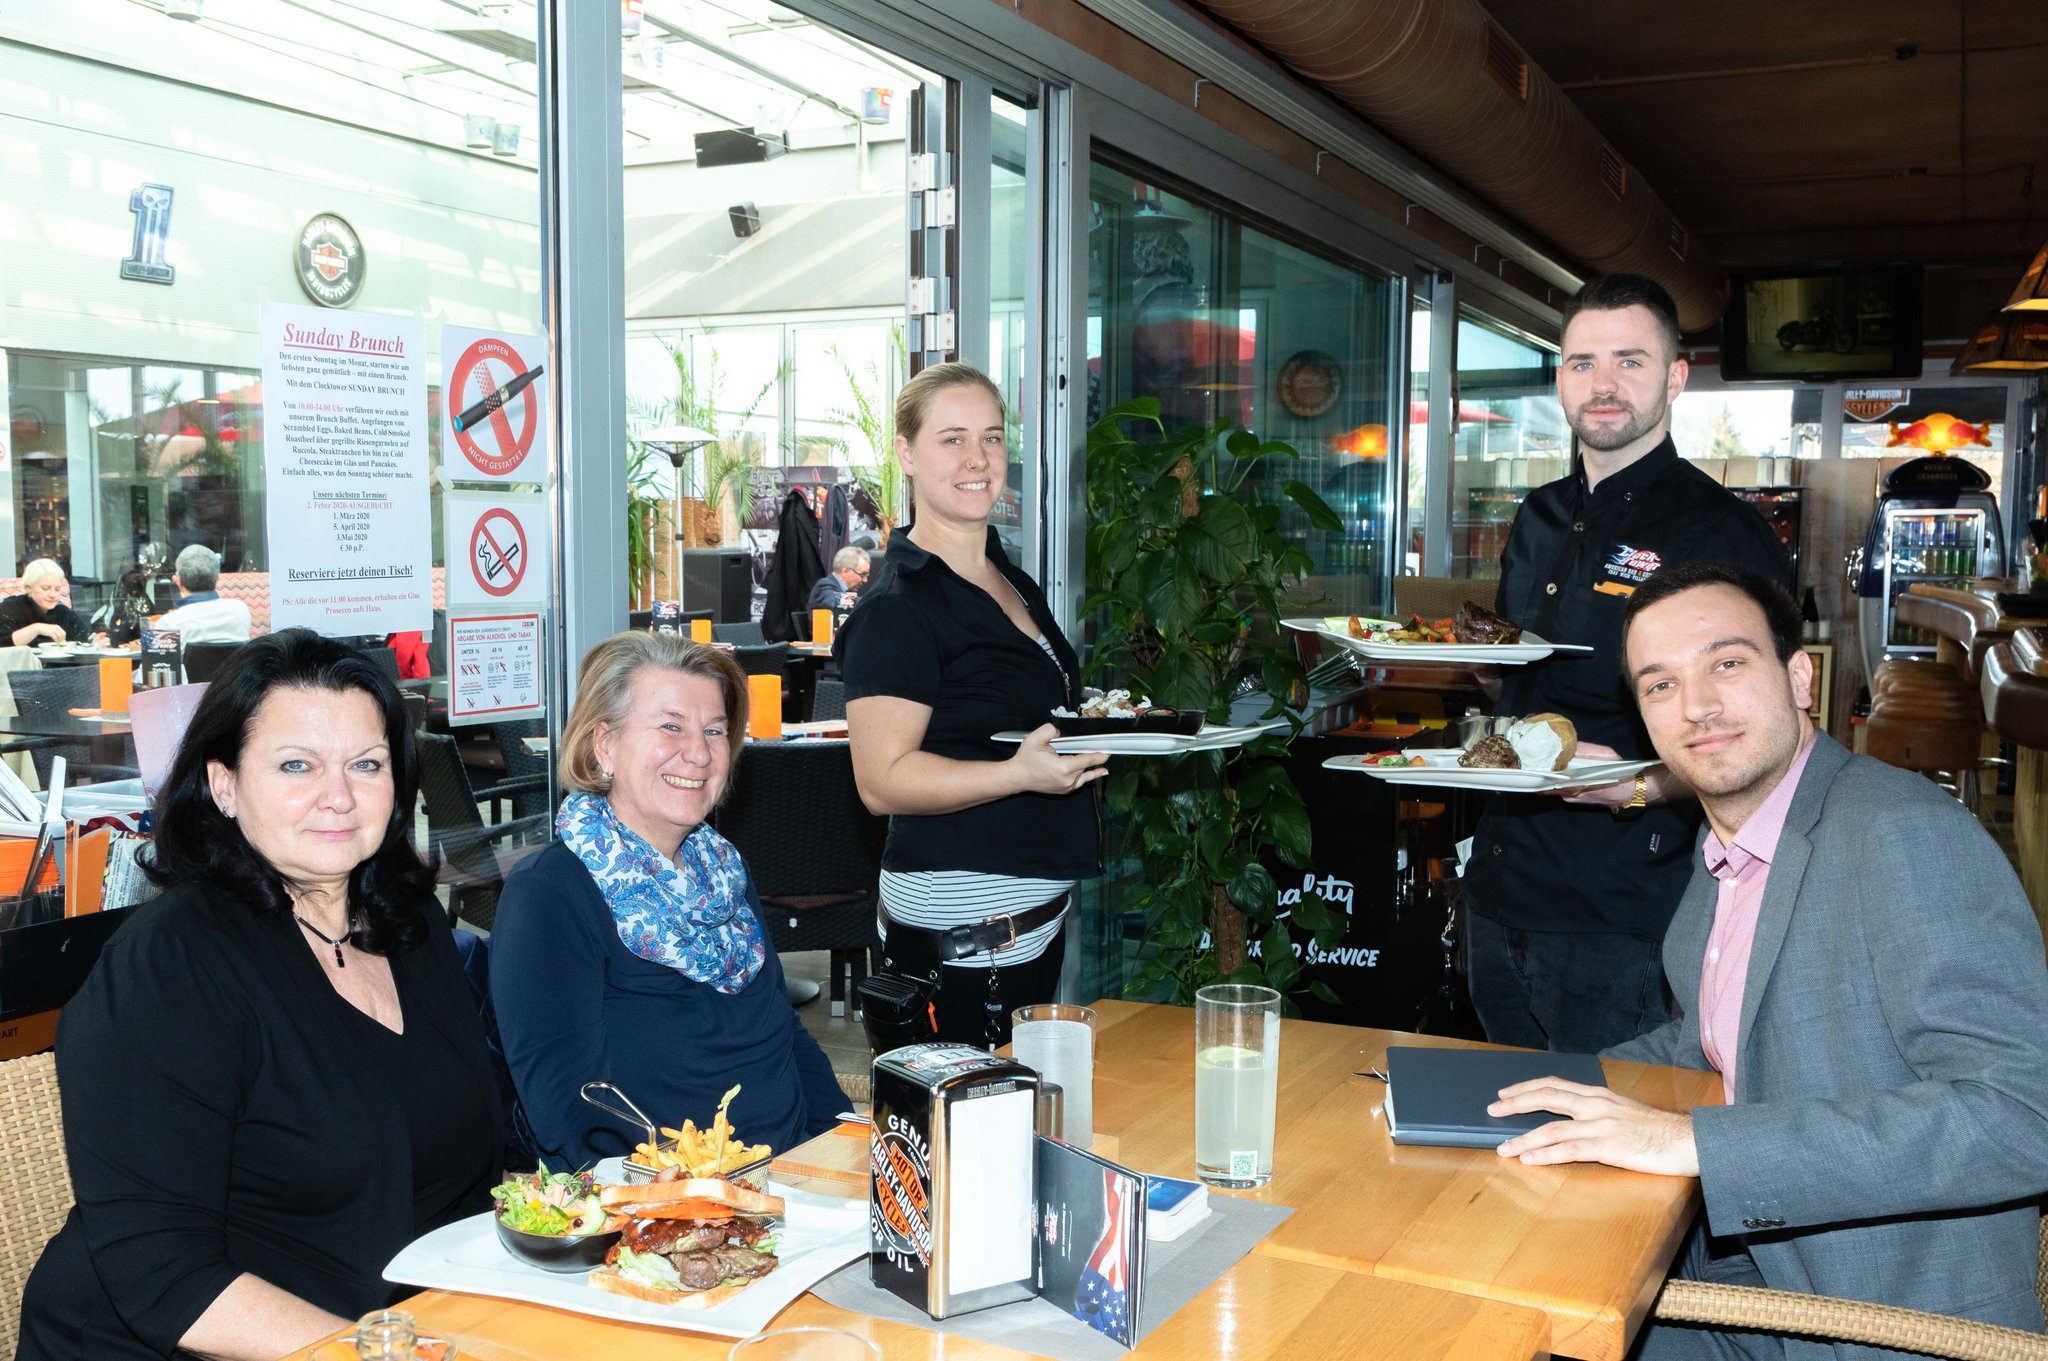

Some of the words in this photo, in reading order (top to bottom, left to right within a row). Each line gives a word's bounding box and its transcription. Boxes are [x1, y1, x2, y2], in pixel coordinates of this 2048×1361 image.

[306, 270, 352, 298] MOTORCYCLES
[284, 323, 343, 349] Sunday
[350, 330, 404, 353] Brunch
[478, 344, 509, 357] DAMPFEN
[293, 353, 312, 361] ersten
[313, 355, 337, 365] Sonntag
[349, 359, 368, 368] Monat,
[281, 363, 305, 371] liebsten
[322, 368, 351, 376] gemütlich
[386, 373, 408, 381] Brunch.
[286, 379, 297, 387] Mit
[314, 382, 347, 391] Clocktower
[349, 384, 376, 393] SUNDAY
[378, 387, 405, 395] BRUNCH
[1845, 389, 1902, 399] RLEY-DAVIDSON
[283, 401, 296, 409] Von
[345, 406, 373, 414] verführen
[289, 414, 314, 422] unserem
[316, 414, 338, 422] Brunch
[339, 416, 359, 424] Buffet.
[361, 418, 393, 427] Angefangen
[284, 424, 315, 432] Scrambled
[317, 426, 333, 435] Eggs,
[354, 428, 372, 436] Beans,
[286, 435, 315, 443] Roastbeef
[317, 436, 330, 444] über
[331, 438, 355, 446] gegrillte
[357, 439, 398, 447] Riesengarnelen
[293, 446, 317, 454] Ruccola,
[319, 447, 361, 456] Steaktranchen
[468, 446, 488, 467] NICHT
[489, 450, 523, 470] GESTATTET
[300, 458, 333, 466] Cheesecake
[344, 459, 356, 467] Glas
[371, 460, 398, 468] Pancakes.
[282, 468, 305, 476] Einfach
[307, 469, 322, 477] alles,
[348, 470, 371, 478] Sonntag
[373, 470, 393, 478] schöner
[362, 491, 387, 499] Termine:
[990, 502, 1018, 518] OTEL
[353, 545, 364, 553] p.P.
[288, 568, 335, 579] Reserviere
[338, 567, 356, 579] jetzt
[359, 566, 386, 577] deinen
[388, 565, 413, 575] Tisch!
[1305, 937, 1380, 968] SERVICE
[0, 1027, 17, 1039] ART
[888, 1114, 930, 1162] GENU
[893, 1150, 923, 1204] MOTOR
[872, 1131, 930, 1258] HARLEY-DAVIDSON
[879, 1182, 906, 1233] CYCLES
[886, 1245, 914, 1273] OIL
